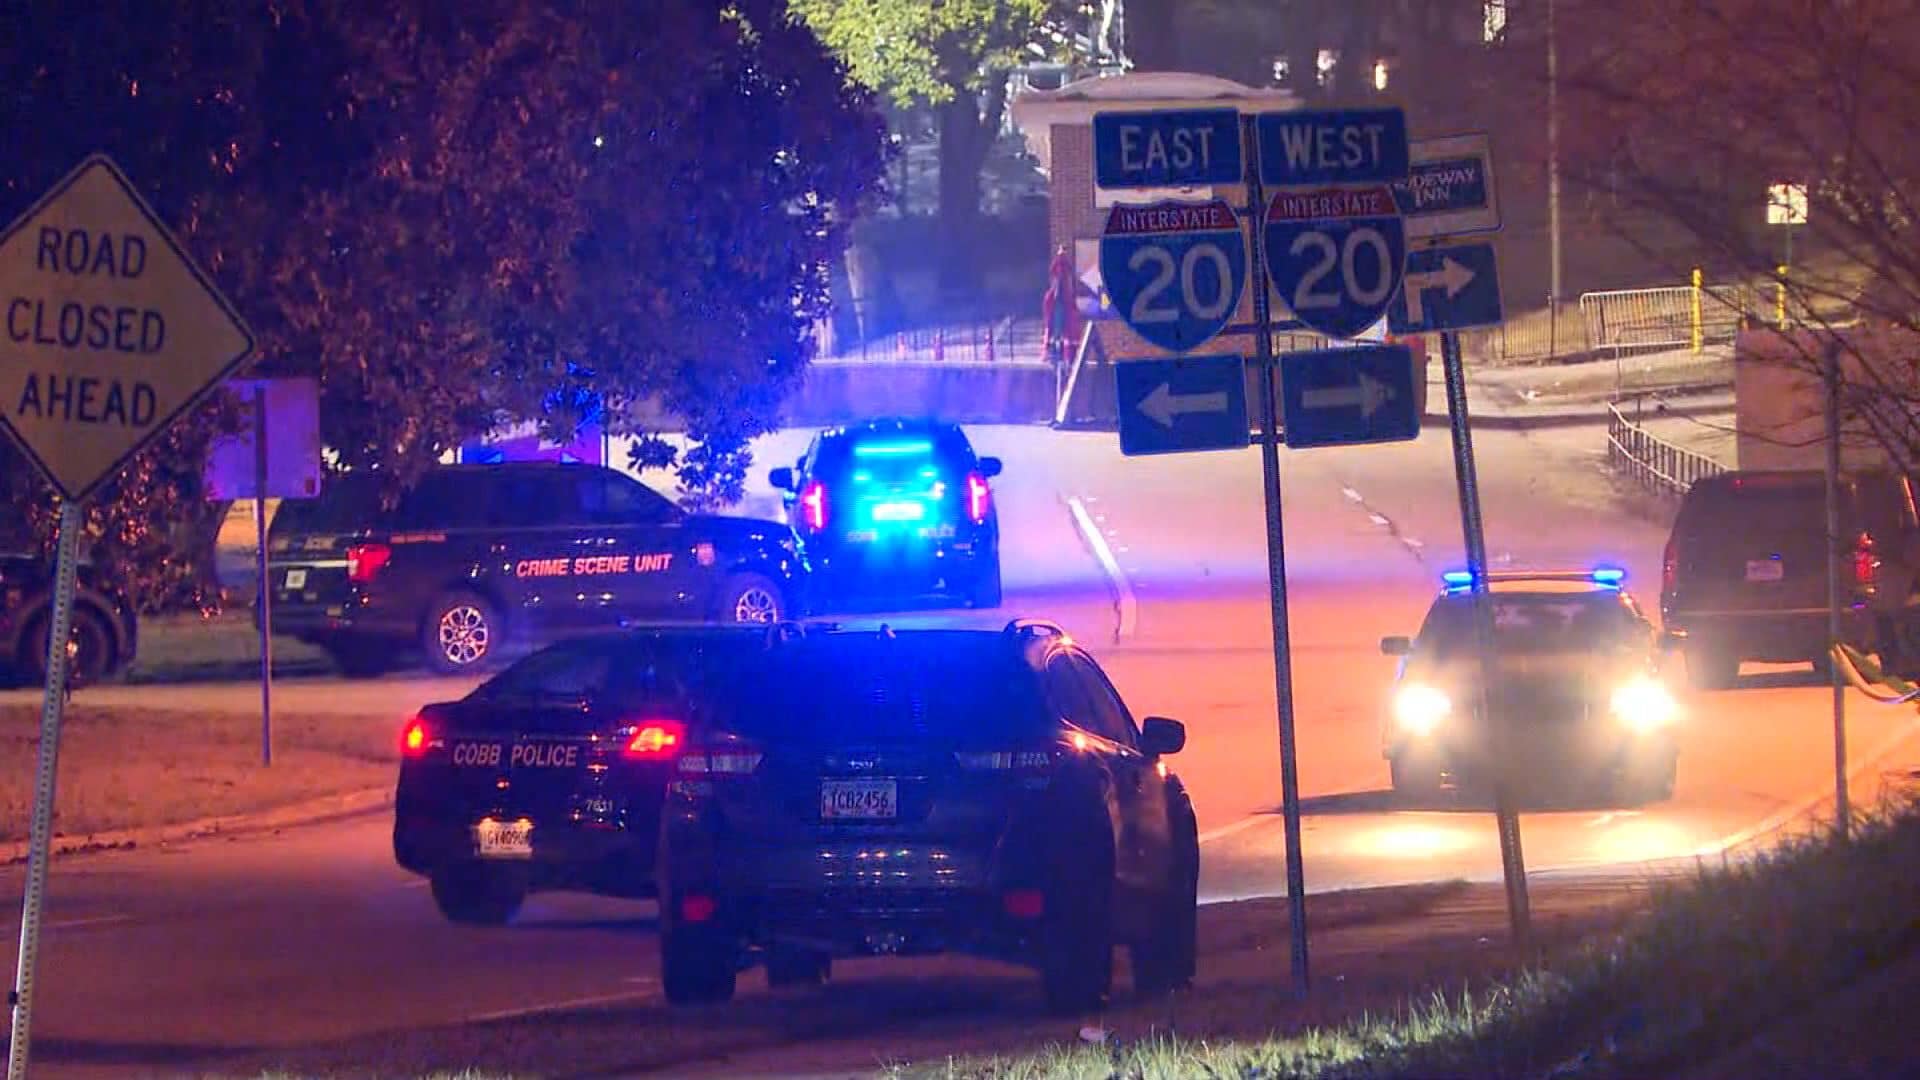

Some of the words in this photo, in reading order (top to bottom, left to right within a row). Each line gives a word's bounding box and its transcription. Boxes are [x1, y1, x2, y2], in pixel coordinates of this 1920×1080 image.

[1120, 125, 1215, 172] EAST
[1280, 123, 1384, 170] WEST
[1120, 206, 1221, 230] INTERSTATE
[1282, 190, 1379, 215] INTERSTATE
[1415, 185, 1449, 207] INN
[37, 227, 146, 280] ROAD
[1288, 227, 1393, 308] 20
[1129, 243, 1234, 323] 20
[7, 297, 166, 354] CLOSED
[17, 371, 156, 428] AHEAD
[516, 558, 569, 577] CRIME
[573, 556, 629, 575] SCENE
[634, 553, 672, 572] UNIT
[453, 743, 500, 765] COBB
[511, 744, 577, 767] POLICE
